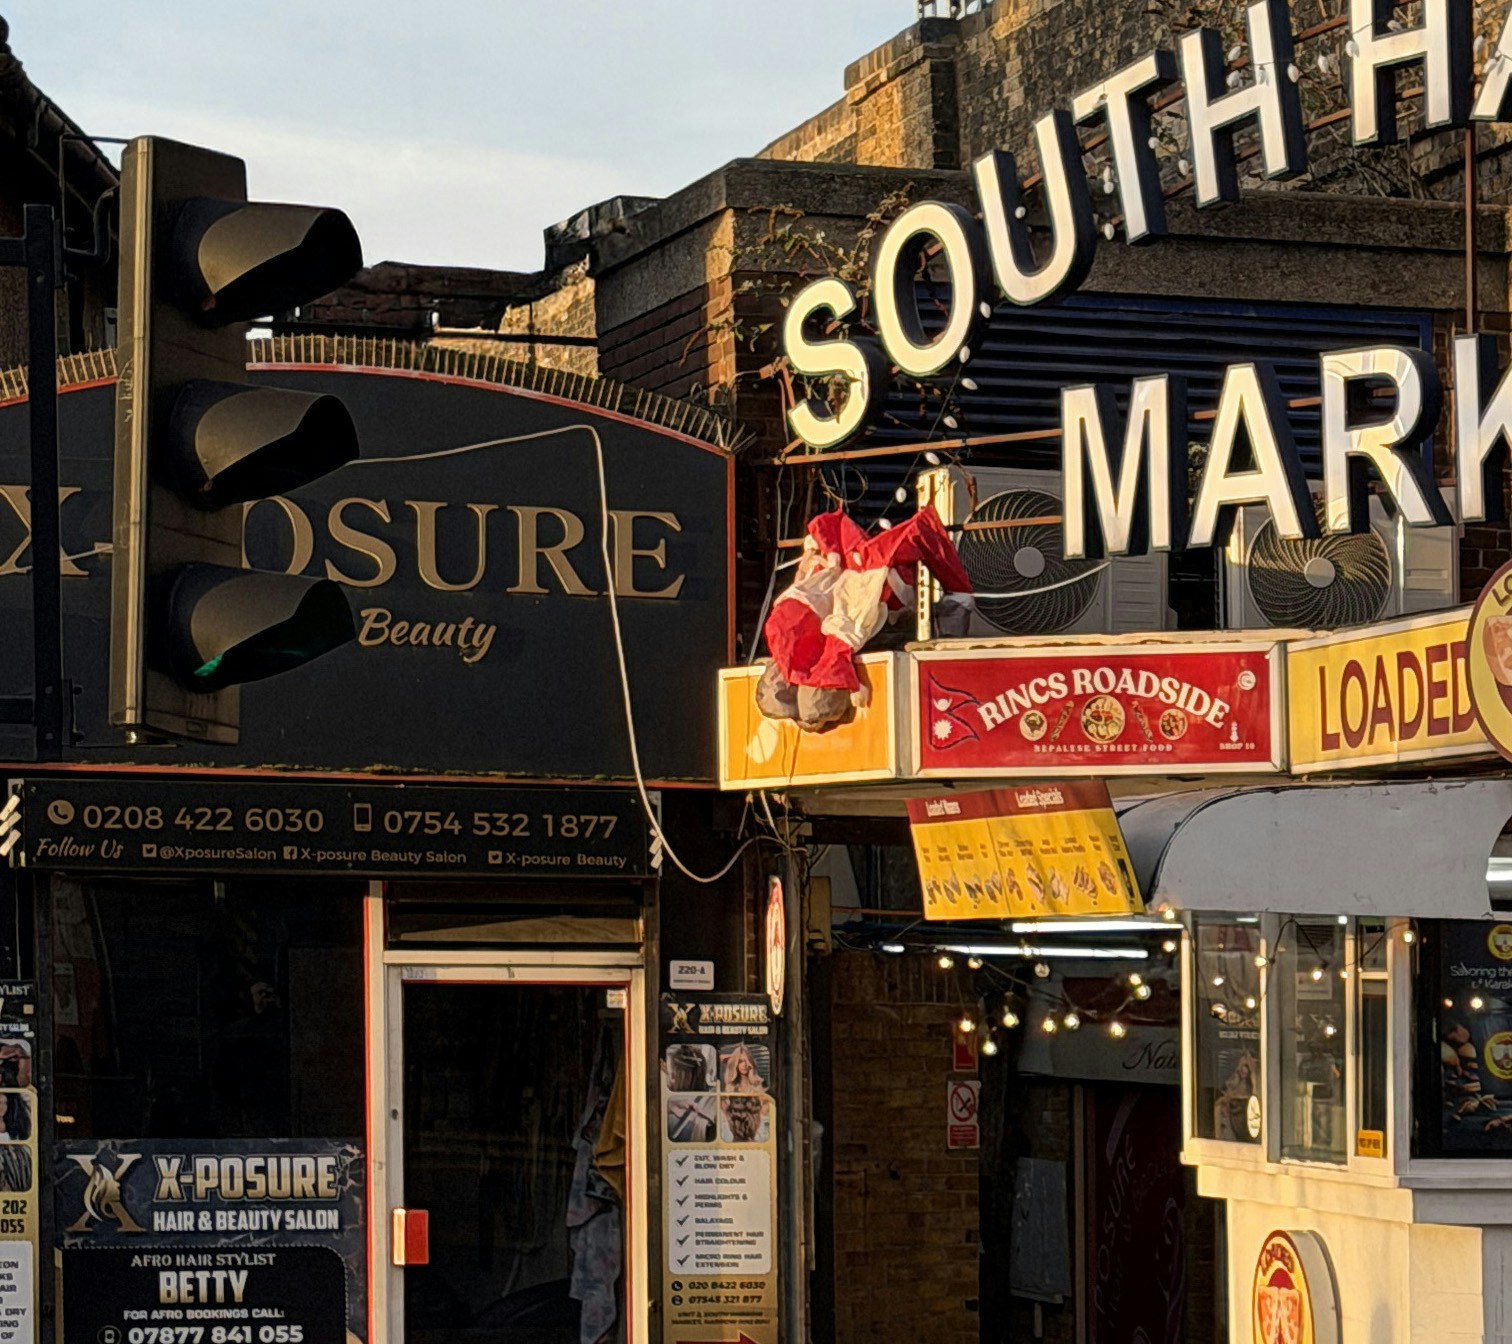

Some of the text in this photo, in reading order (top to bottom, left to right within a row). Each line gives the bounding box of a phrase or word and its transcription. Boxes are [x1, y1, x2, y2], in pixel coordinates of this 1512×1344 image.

[357, 607, 496, 664] Beauty
[1072, 666, 1231, 729] ROADSIDE
[1319, 640, 1478, 752] LOADED
[1095, 744, 1137, 753] STREET
[1142, 743, 1173, 752] FOOD
[83, 805, 618, 839] 0208 422 6030 0754 532 1877
[36, 836, 627, 868] Follow Us @XposureSalon X-posure Beauty Salon X-posure Beauty
[699, 1004, 768, 1024] X-POSURE
[155, 1155, 339, 1200] X-POSURE
[2, 1199, 27, 1215] 202
[0, 1219, 25, 1234] 055
[153, 1209, 339, 1232] HAIR & BEAUTY SALON
[130, 1253, 277, 1268] AFRO HAIR STYLIST
[158, 1270, 249, 1304] BETTY
[124, 1310, 147, 1320] FOR
[150, 1309, 183, 1320] AFRO
[186, 1309, 248, 1320] BOOKINGS
[128, 1325, 304, 1344] 07877 841 055
